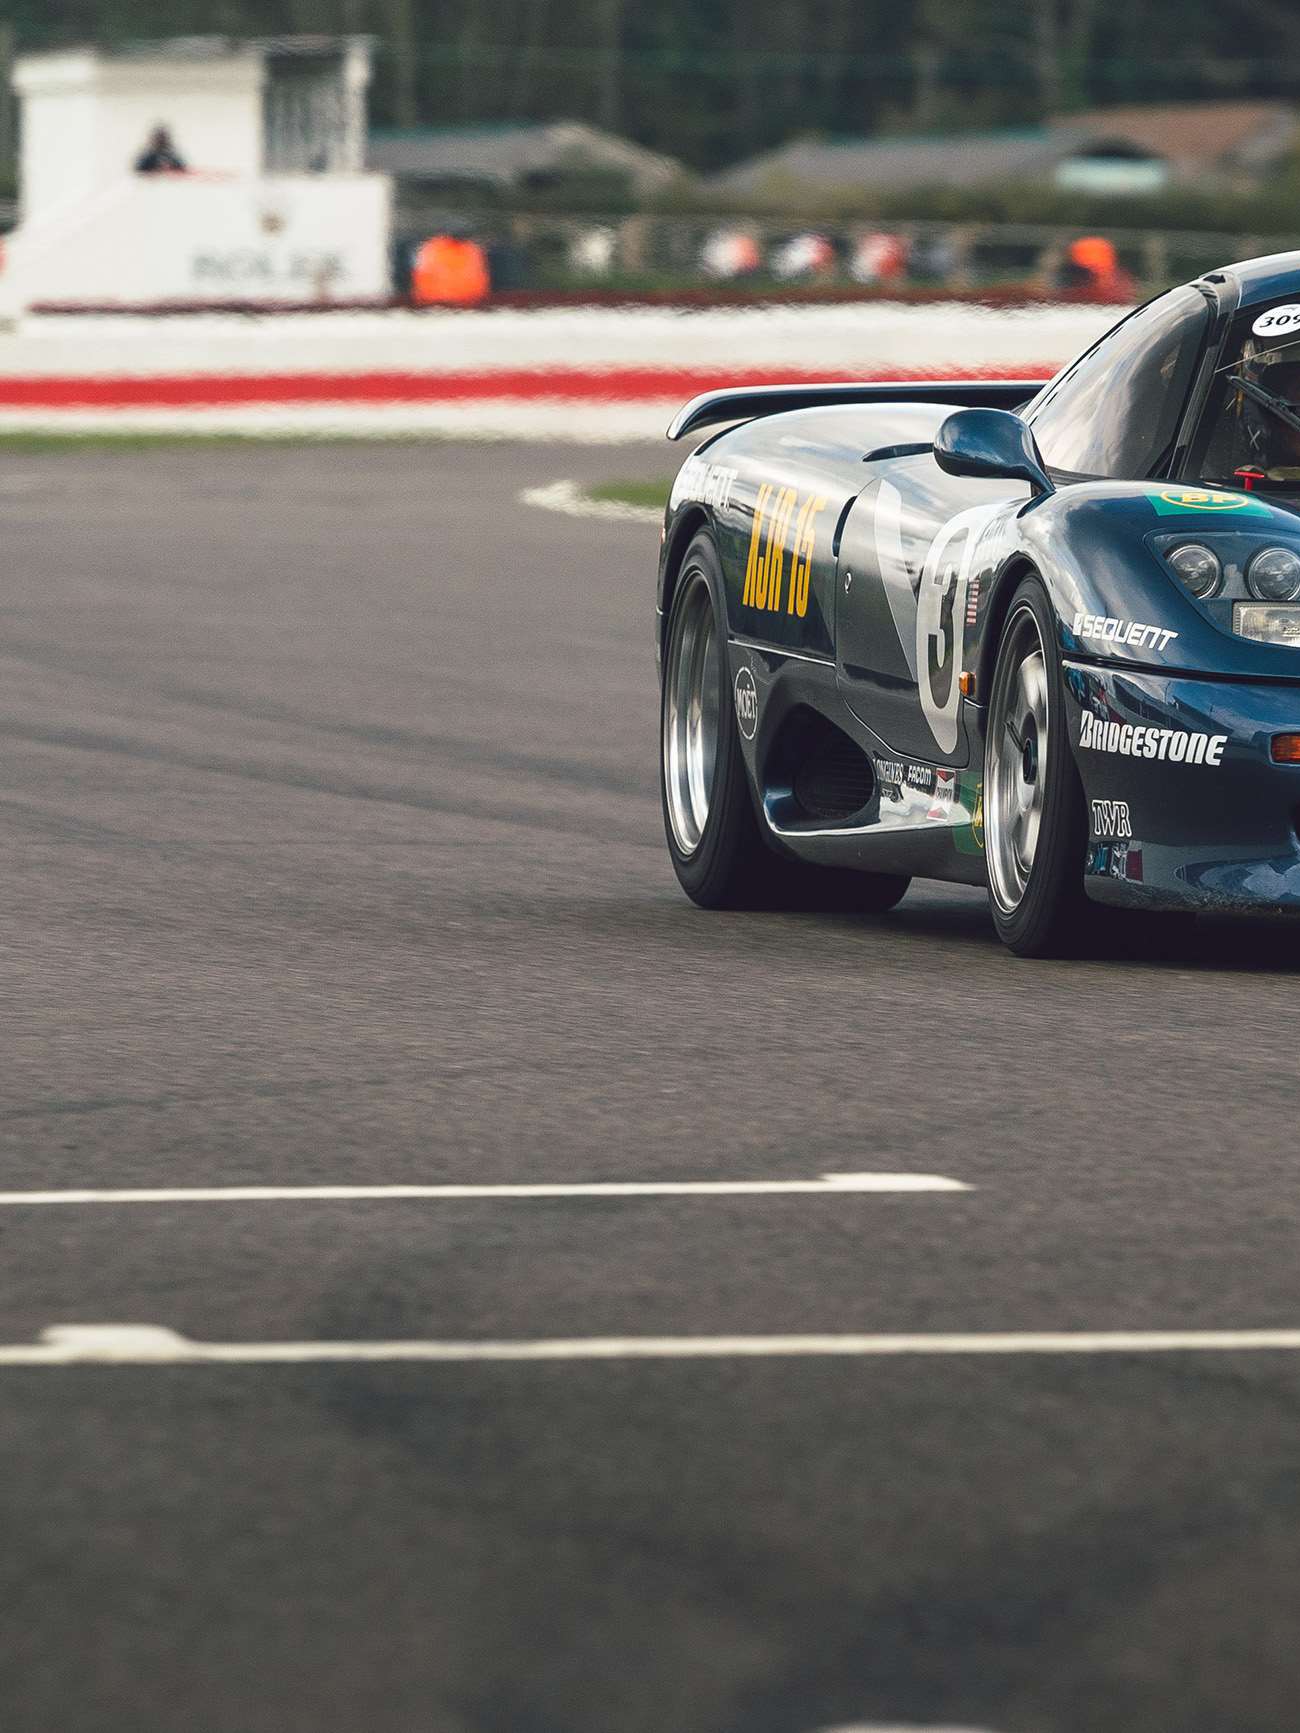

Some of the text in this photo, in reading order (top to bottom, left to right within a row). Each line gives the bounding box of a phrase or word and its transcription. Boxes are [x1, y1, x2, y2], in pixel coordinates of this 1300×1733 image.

[1182, 491, 1239, 503] BP
[743, 484, 829, 617] XJR 15
[928, 527, 969, 709] 3
[1082, 614, 1178, 651] SEQUENT
[1079, 710, 1228, 766] BRIDGESTONE
[1092, 799, 1132, 837] TWR
